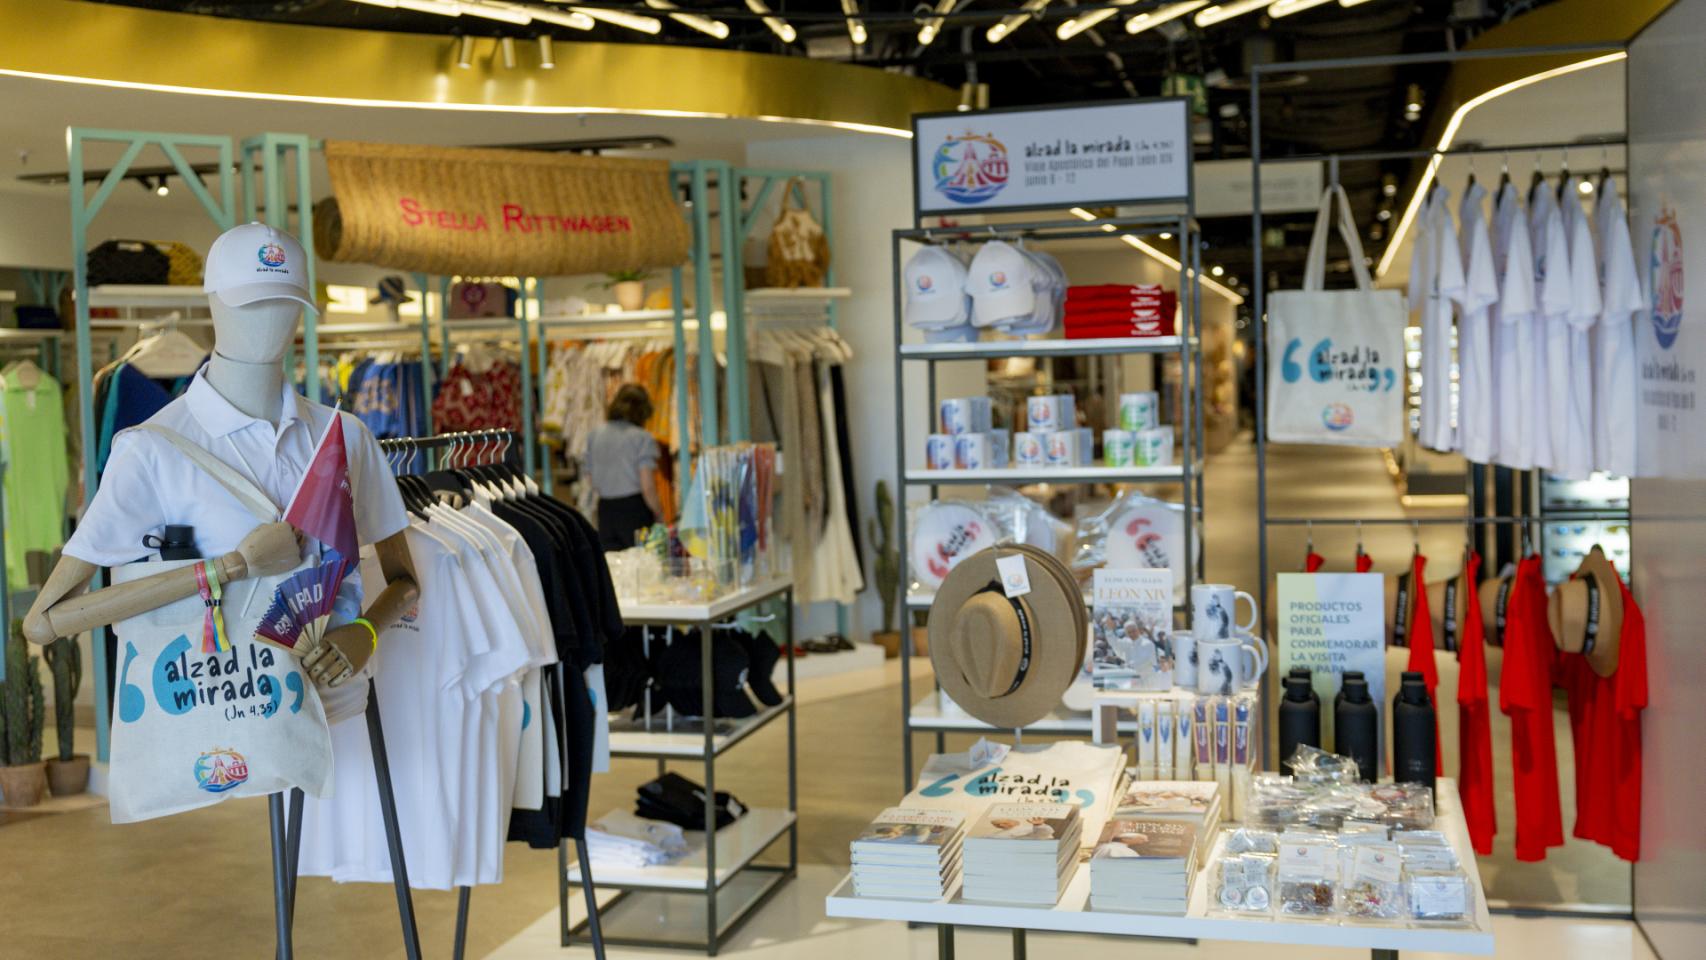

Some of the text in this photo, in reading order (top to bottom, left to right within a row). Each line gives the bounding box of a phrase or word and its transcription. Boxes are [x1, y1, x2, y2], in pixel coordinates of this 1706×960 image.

[1025, 139, 1061, 157] alzad
[1064, 139, 1078, 154] la
[1082, 135, 1131, 153] mirada
[1097, 156, 1110, 168] del
[1113, 155, 1134, 168] Papa
[1317, 346, 1379, 365] alzad la
[1319, 363, 1378, 381] mirada
[1290, 602, 1362, 612] PRODUCTOS
[1290, 614, 1351, 624] OFICIALES
[1290, 627, 1321, 636] PARA
[1290, 639, 1378, 649] CONMEMORAR
[165, 643, 275, 682] alzad la
[1291, 652, 1346, 661] LA VISITA
[1316, 664, 1346, 673] PAPA
[173, 666, 273, 710] mirada
[224, 704, 246, 721] (Jn
[978, 773, 1071, 788] alzad la
[977, 784, 1064, 796] mirada
